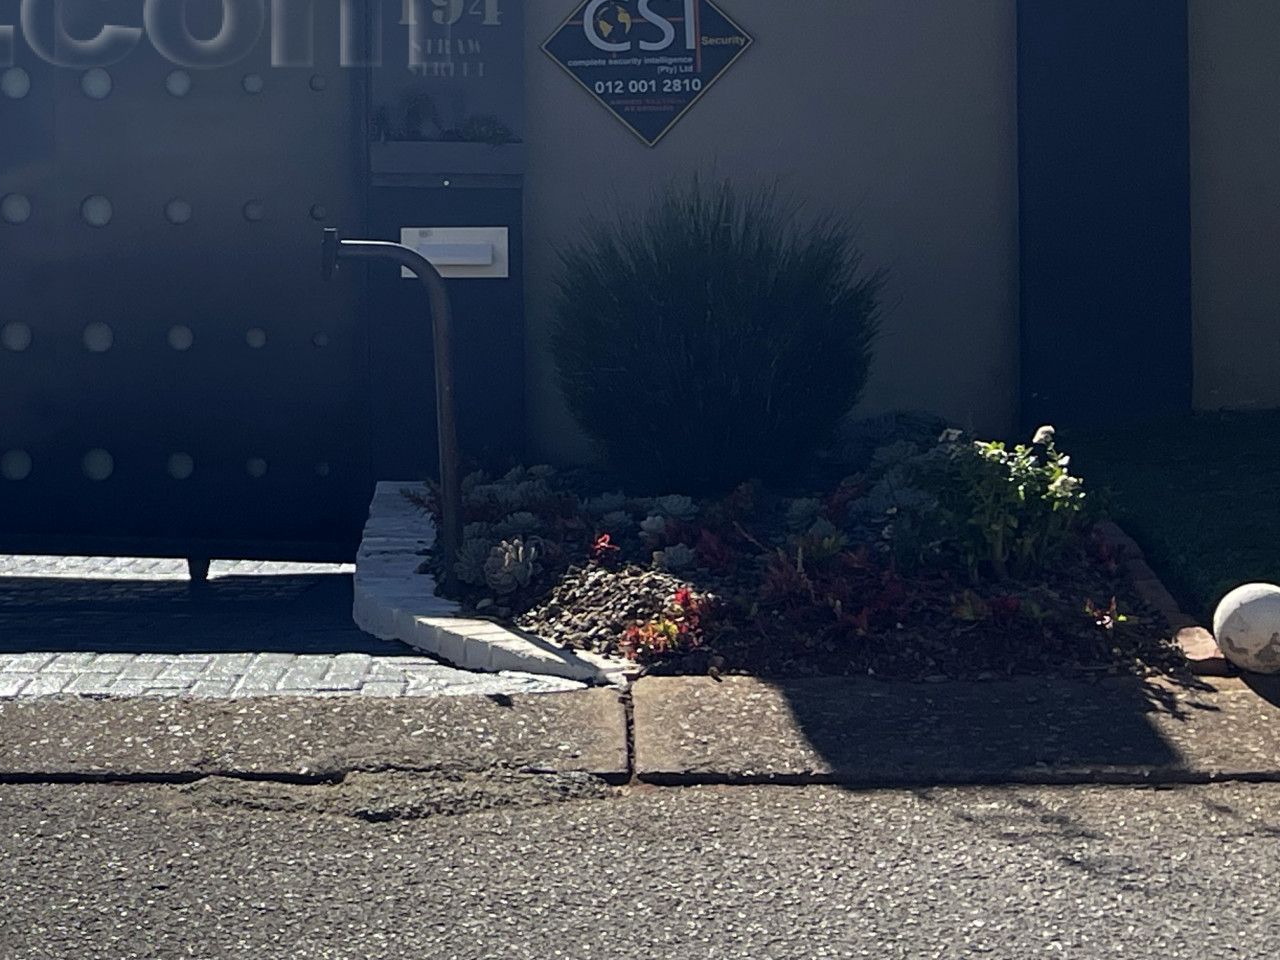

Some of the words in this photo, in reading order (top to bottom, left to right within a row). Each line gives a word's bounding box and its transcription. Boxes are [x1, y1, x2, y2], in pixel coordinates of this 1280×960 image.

[701, 34, 746, 47] Security
[568, 57, 606, 68] complete
[608, 57, 642, 67] security
[644, 56, 693, 67] intelligence
[679, 65, 693, 74] Ltd
[595, 80, 624, 94] 012
[628, 80, 656, 93] 001
[662, 78, 702, 93] 2810
